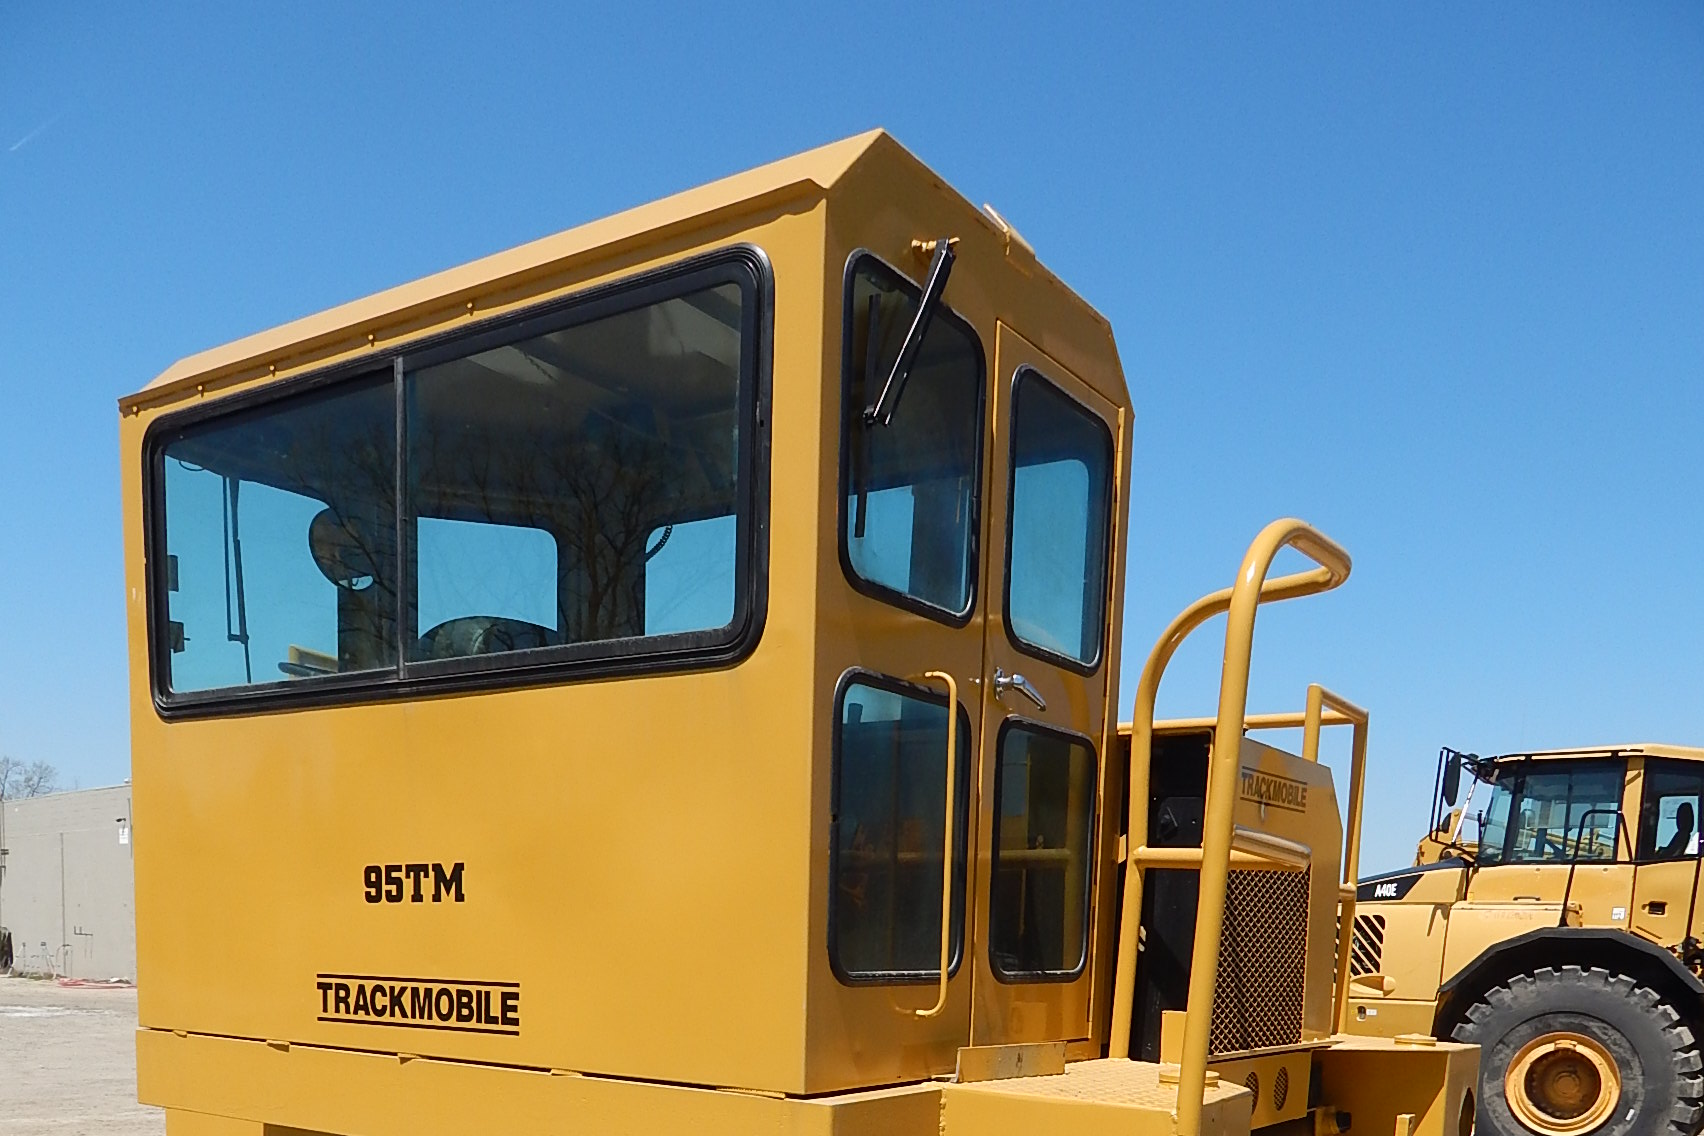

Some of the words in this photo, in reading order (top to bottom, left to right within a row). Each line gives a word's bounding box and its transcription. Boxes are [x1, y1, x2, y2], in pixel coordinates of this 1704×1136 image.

[1241, 772, 1307, 808] TRACKMOBILE
[364, 862, 465, 904] 95TM
[1374, 882, 1398, 898] A40E
[316, 981, 520, 1026] TRACKMOBILE
